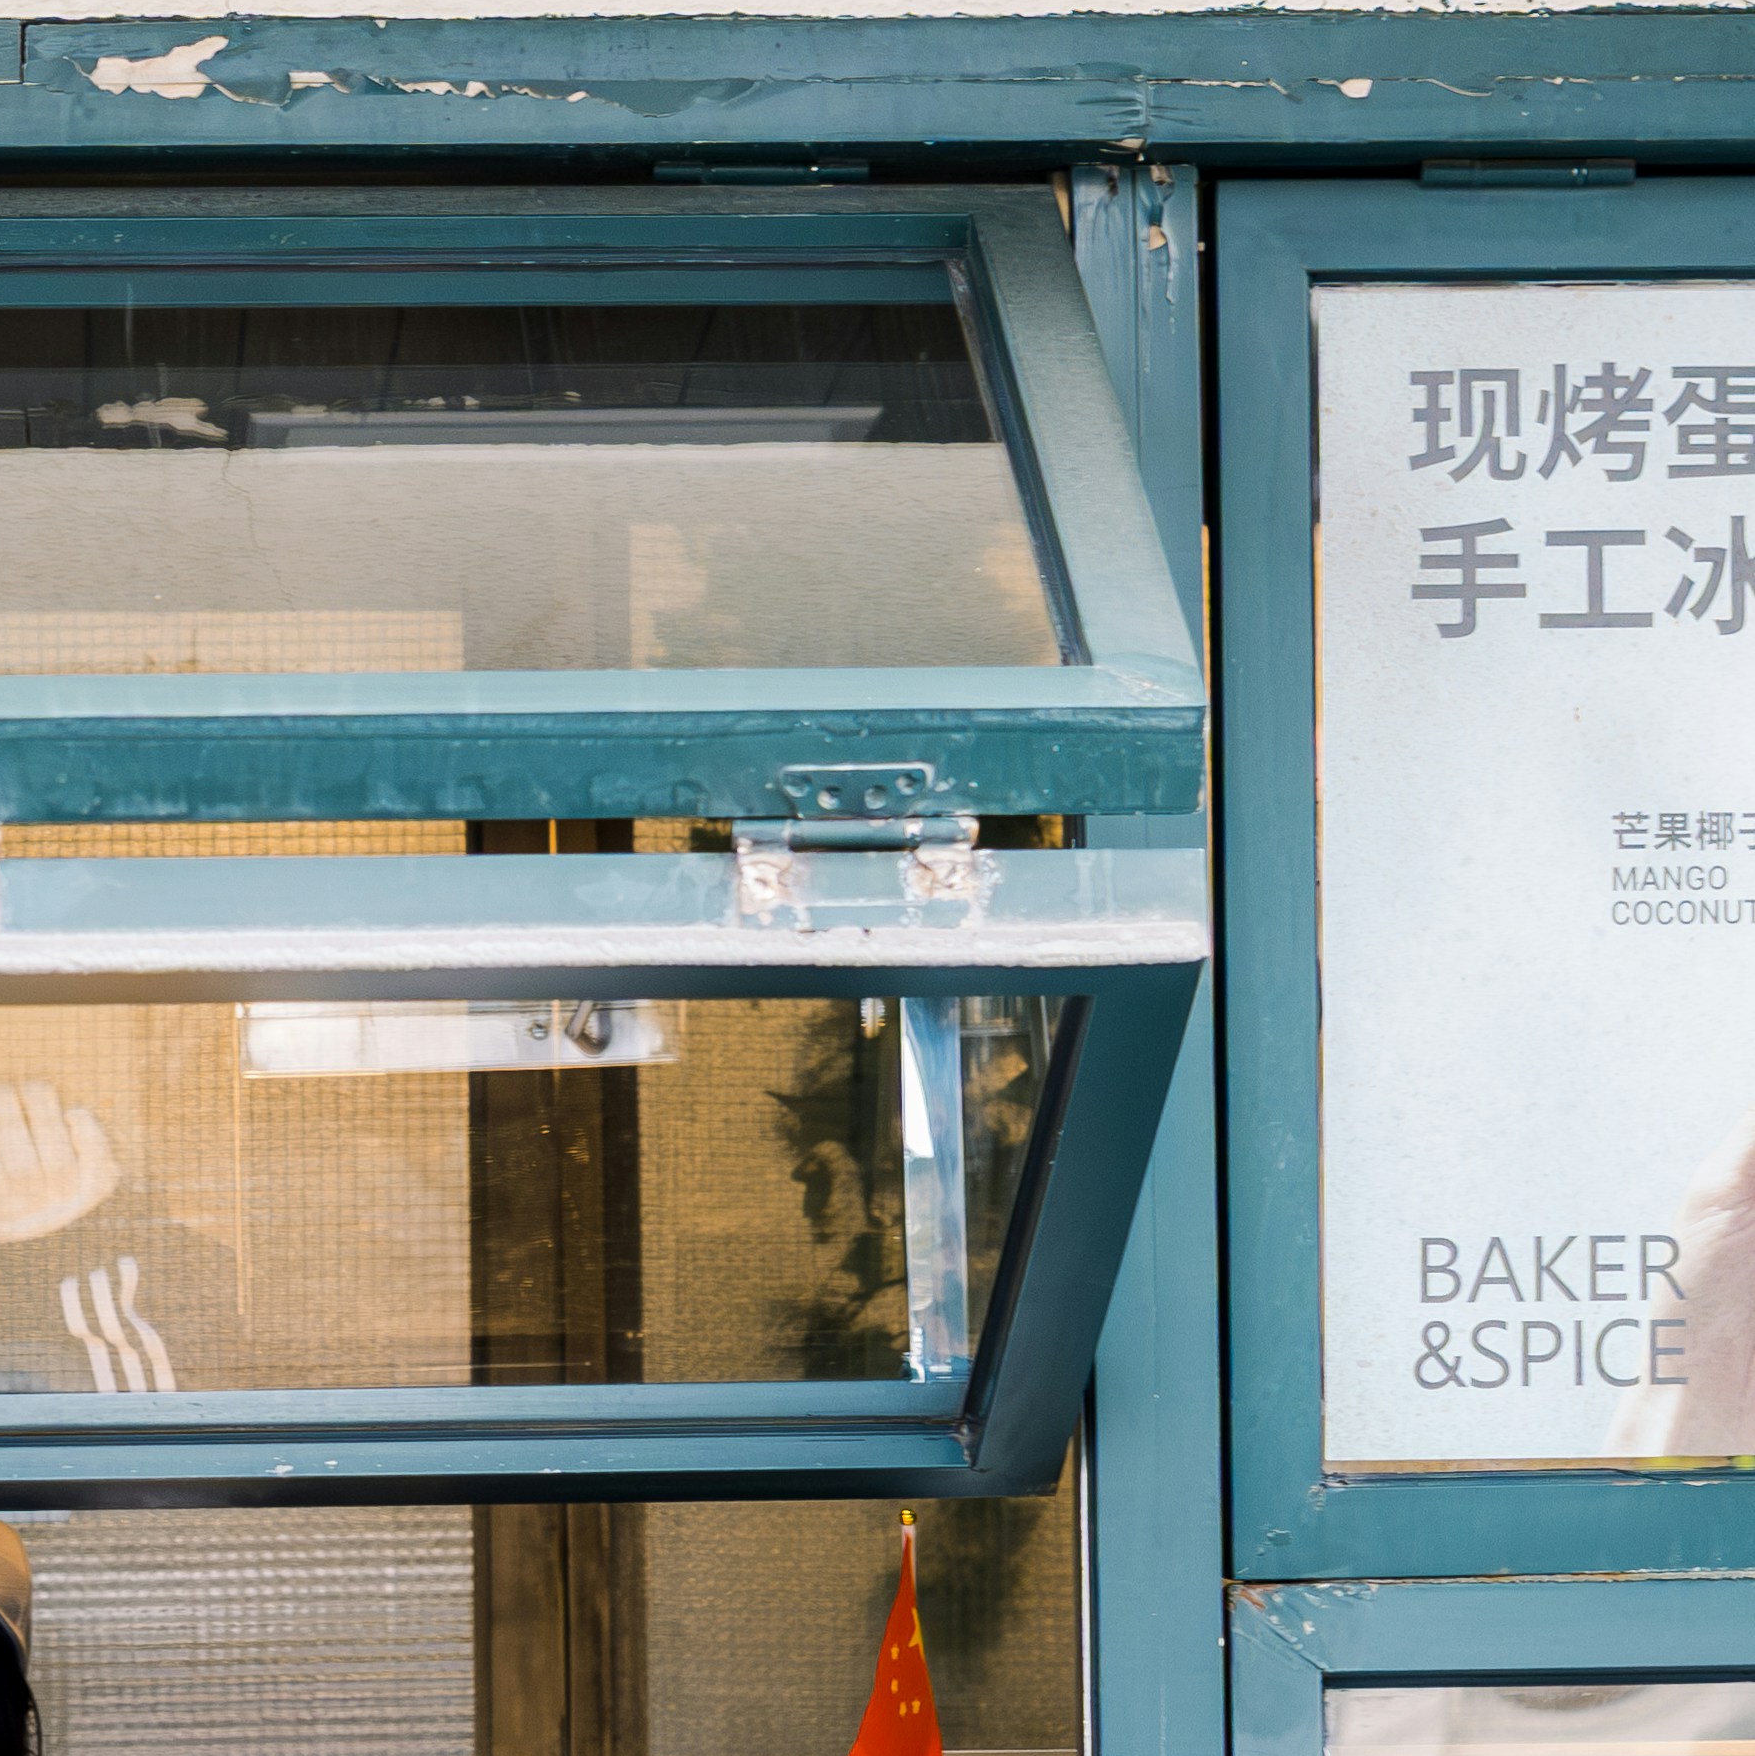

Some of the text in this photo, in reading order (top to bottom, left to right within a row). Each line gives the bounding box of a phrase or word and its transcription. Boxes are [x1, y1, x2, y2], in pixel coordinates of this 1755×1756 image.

[1409, 362, 1755, 483] 现烤蛋
[1411, 516, 1755, 638] 手工冰
[1612, 865, 1727, 891] MANGO
[1612, 899, 1755, 925] COCONUT
[1420, 1234, 1688, 1303] BAKER
[1414, 1318, 1689, 1389] &SPICE
